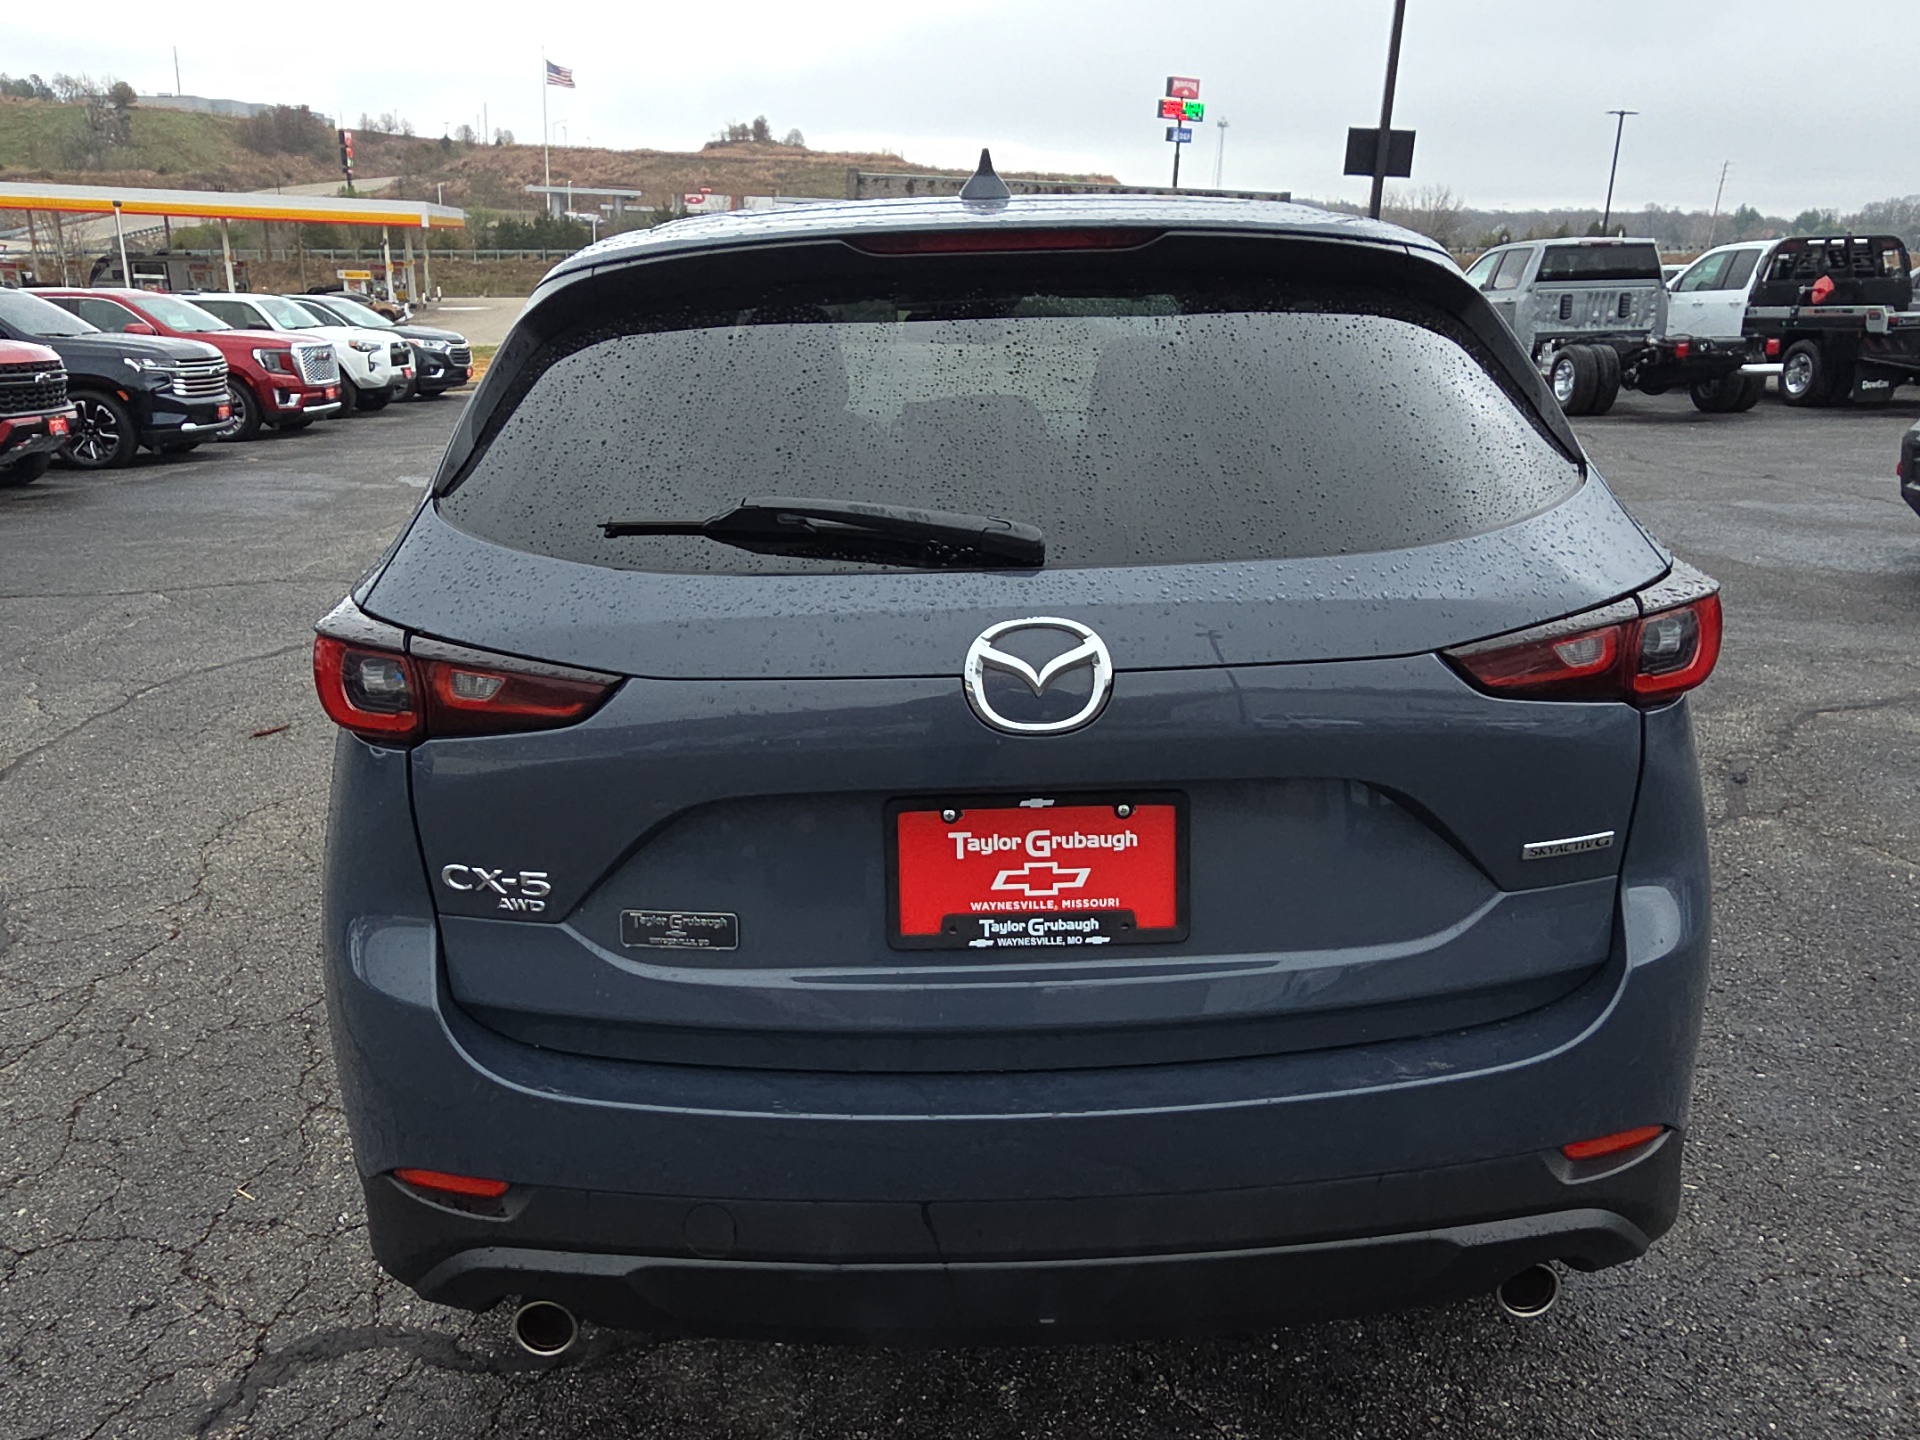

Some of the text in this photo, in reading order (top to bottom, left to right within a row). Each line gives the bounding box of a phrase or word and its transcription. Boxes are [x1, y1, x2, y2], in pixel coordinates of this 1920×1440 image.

[948, 830, 1138, 859] Taylor Grubaugh
[441, 864, 552, 897] CX-5
[497, 897, 546, 912] AWD
[970, 898, 1120, 911] WAYNESVILLE, MISSOURI
[629, 912, 668, 928] Taylor
[979, 918, 1099, 937] Taylor Grubaugh
[997, 936, 1083, 947] WAYNESVILLE, MO
